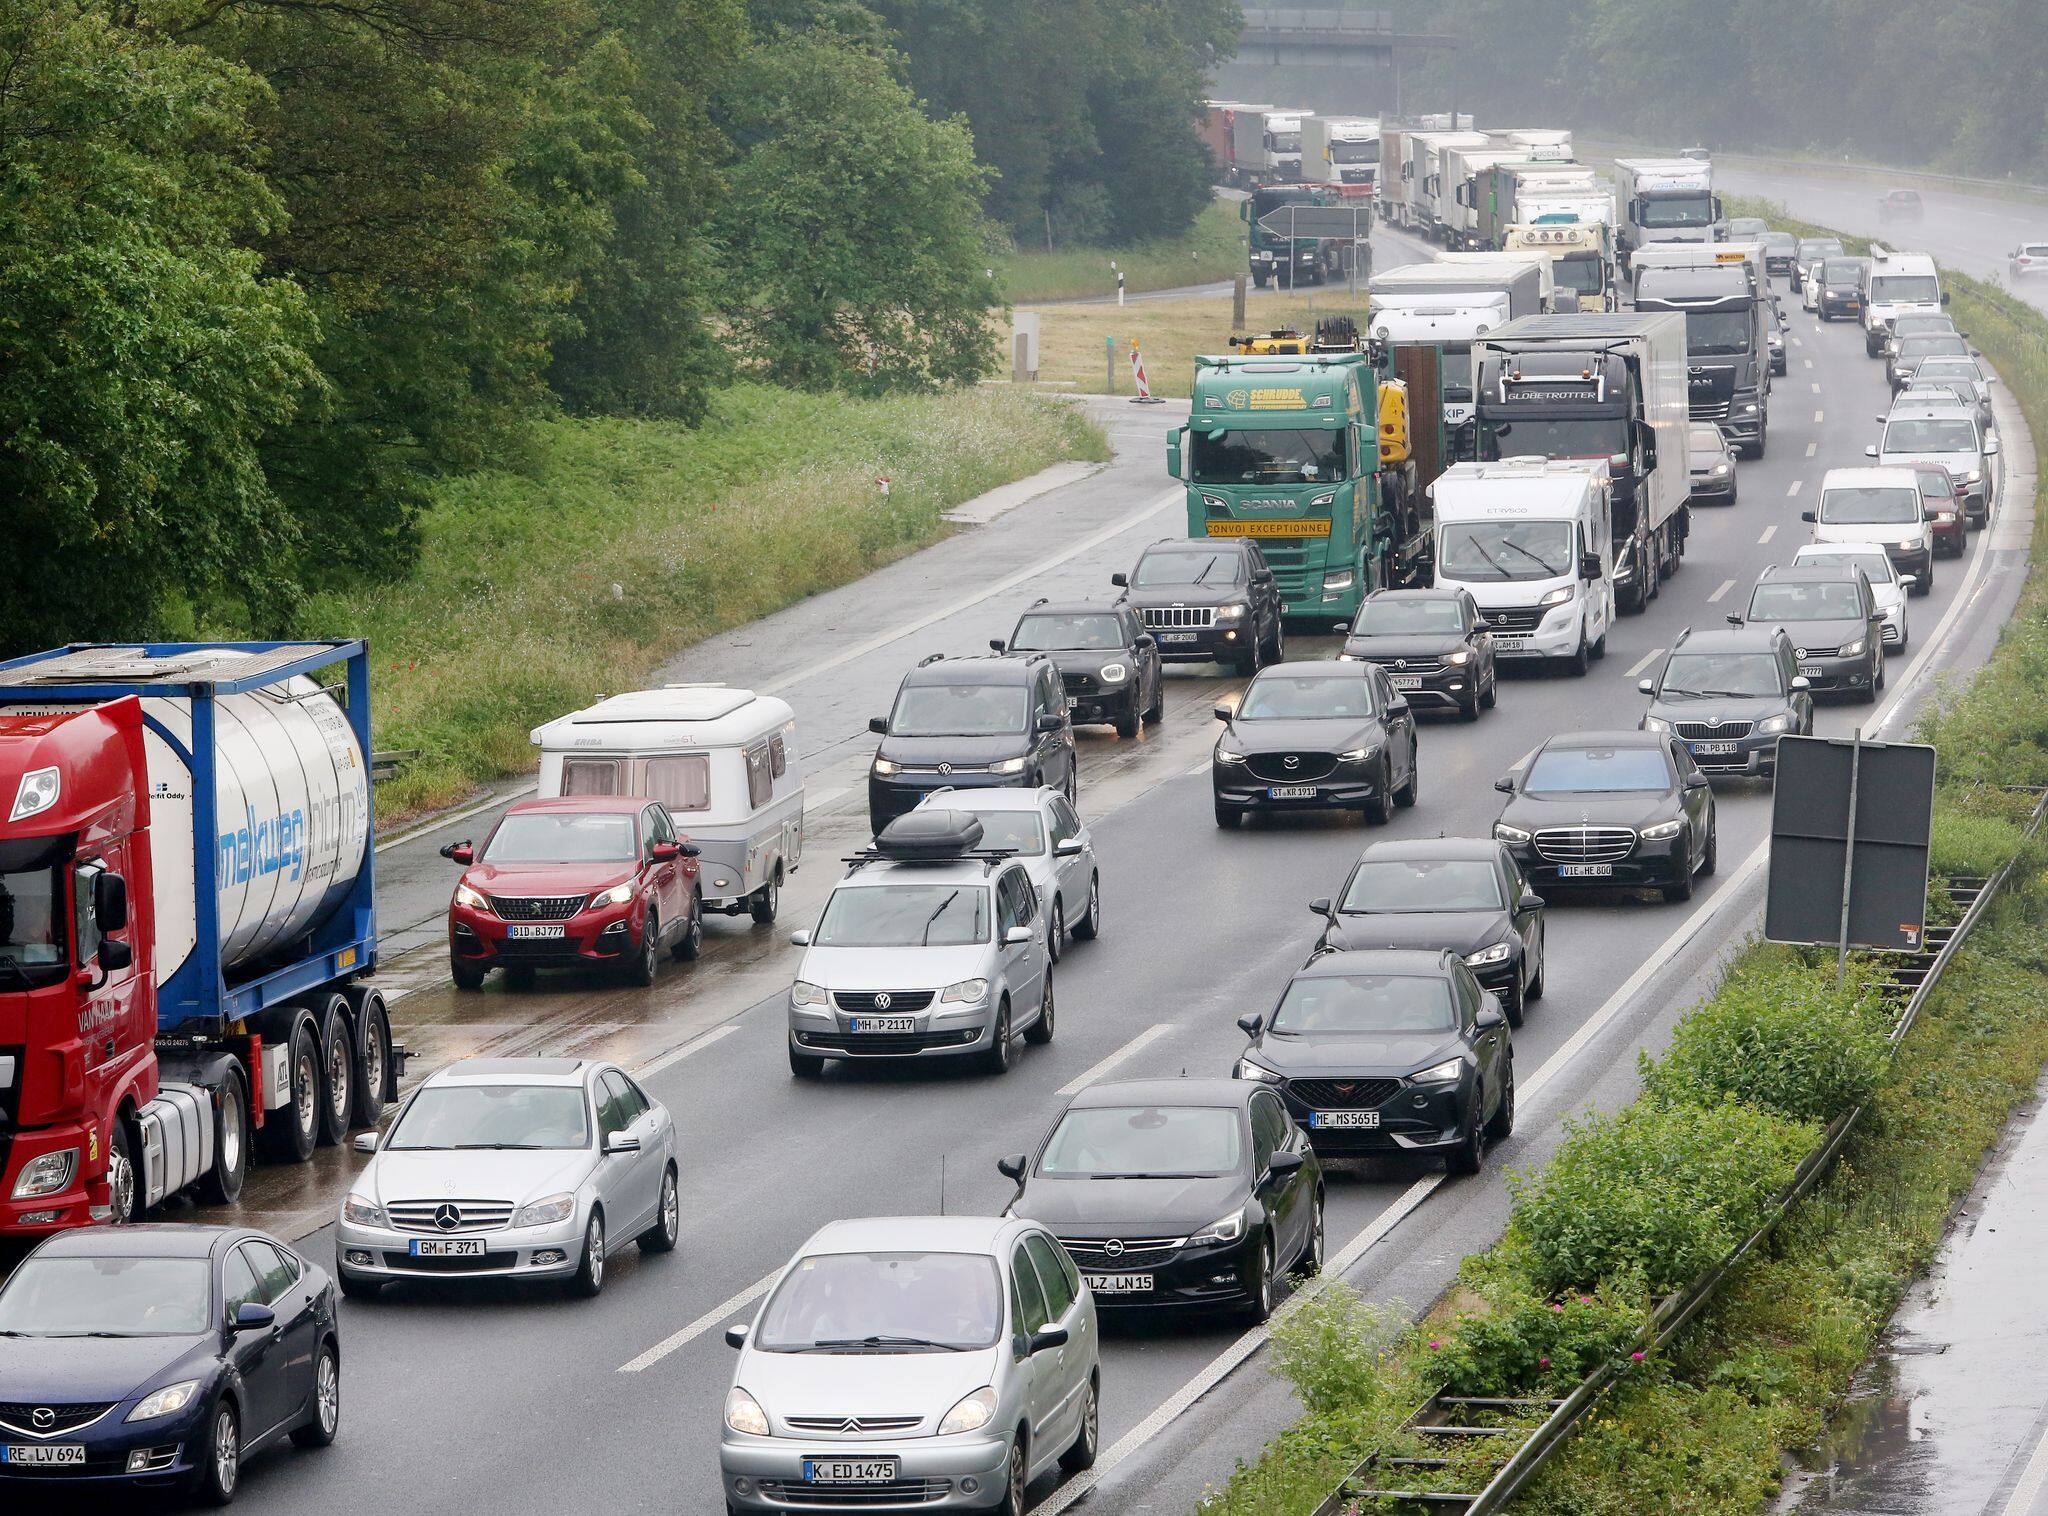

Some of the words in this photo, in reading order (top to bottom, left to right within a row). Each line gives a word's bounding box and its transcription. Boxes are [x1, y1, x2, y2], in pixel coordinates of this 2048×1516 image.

[1250, 388, 1303, 400] SCHRUDDE
[1508, 391, 1597, 400] GLOBETROTTER
[1240, 499, 1298, 510] SCANIA
[1208, 525, 1246, 534] CONVOI
[1250, 523, 1330, 534] EXCEPTIONNEL
[1695, 744, 1706, 753] BN
[166, 792, 185, 801] Oddy
[1273, 788, 1282, 797] ST
[1564, 866, 1579, 876] VIE
[1584, 866, 1595, 875] HE
[513, 926, 530, 937] BID
[78, 1006, 95, 1033] VAN
[857, 1019, 871, 1030] MH
[878, 1019, 886, 1030] P
[887, 1019, 913, 1030] 2117
[1316, 1113, 1330, 1125] ME
[420, 1241, 437, 1255] GM
[445, 1241, 453, 1255] F
[456, 1241, 480, 1255] 371
[8, 1447, 27, 1461] RE
[36, 1447, 54, 1462] LV
[57, 1447, 84, 1462] 694
[812, 1463, 823, 1479] K
[832, 1463, 853, 1479] ED
[855, 1462, 893, 1479] 1475
